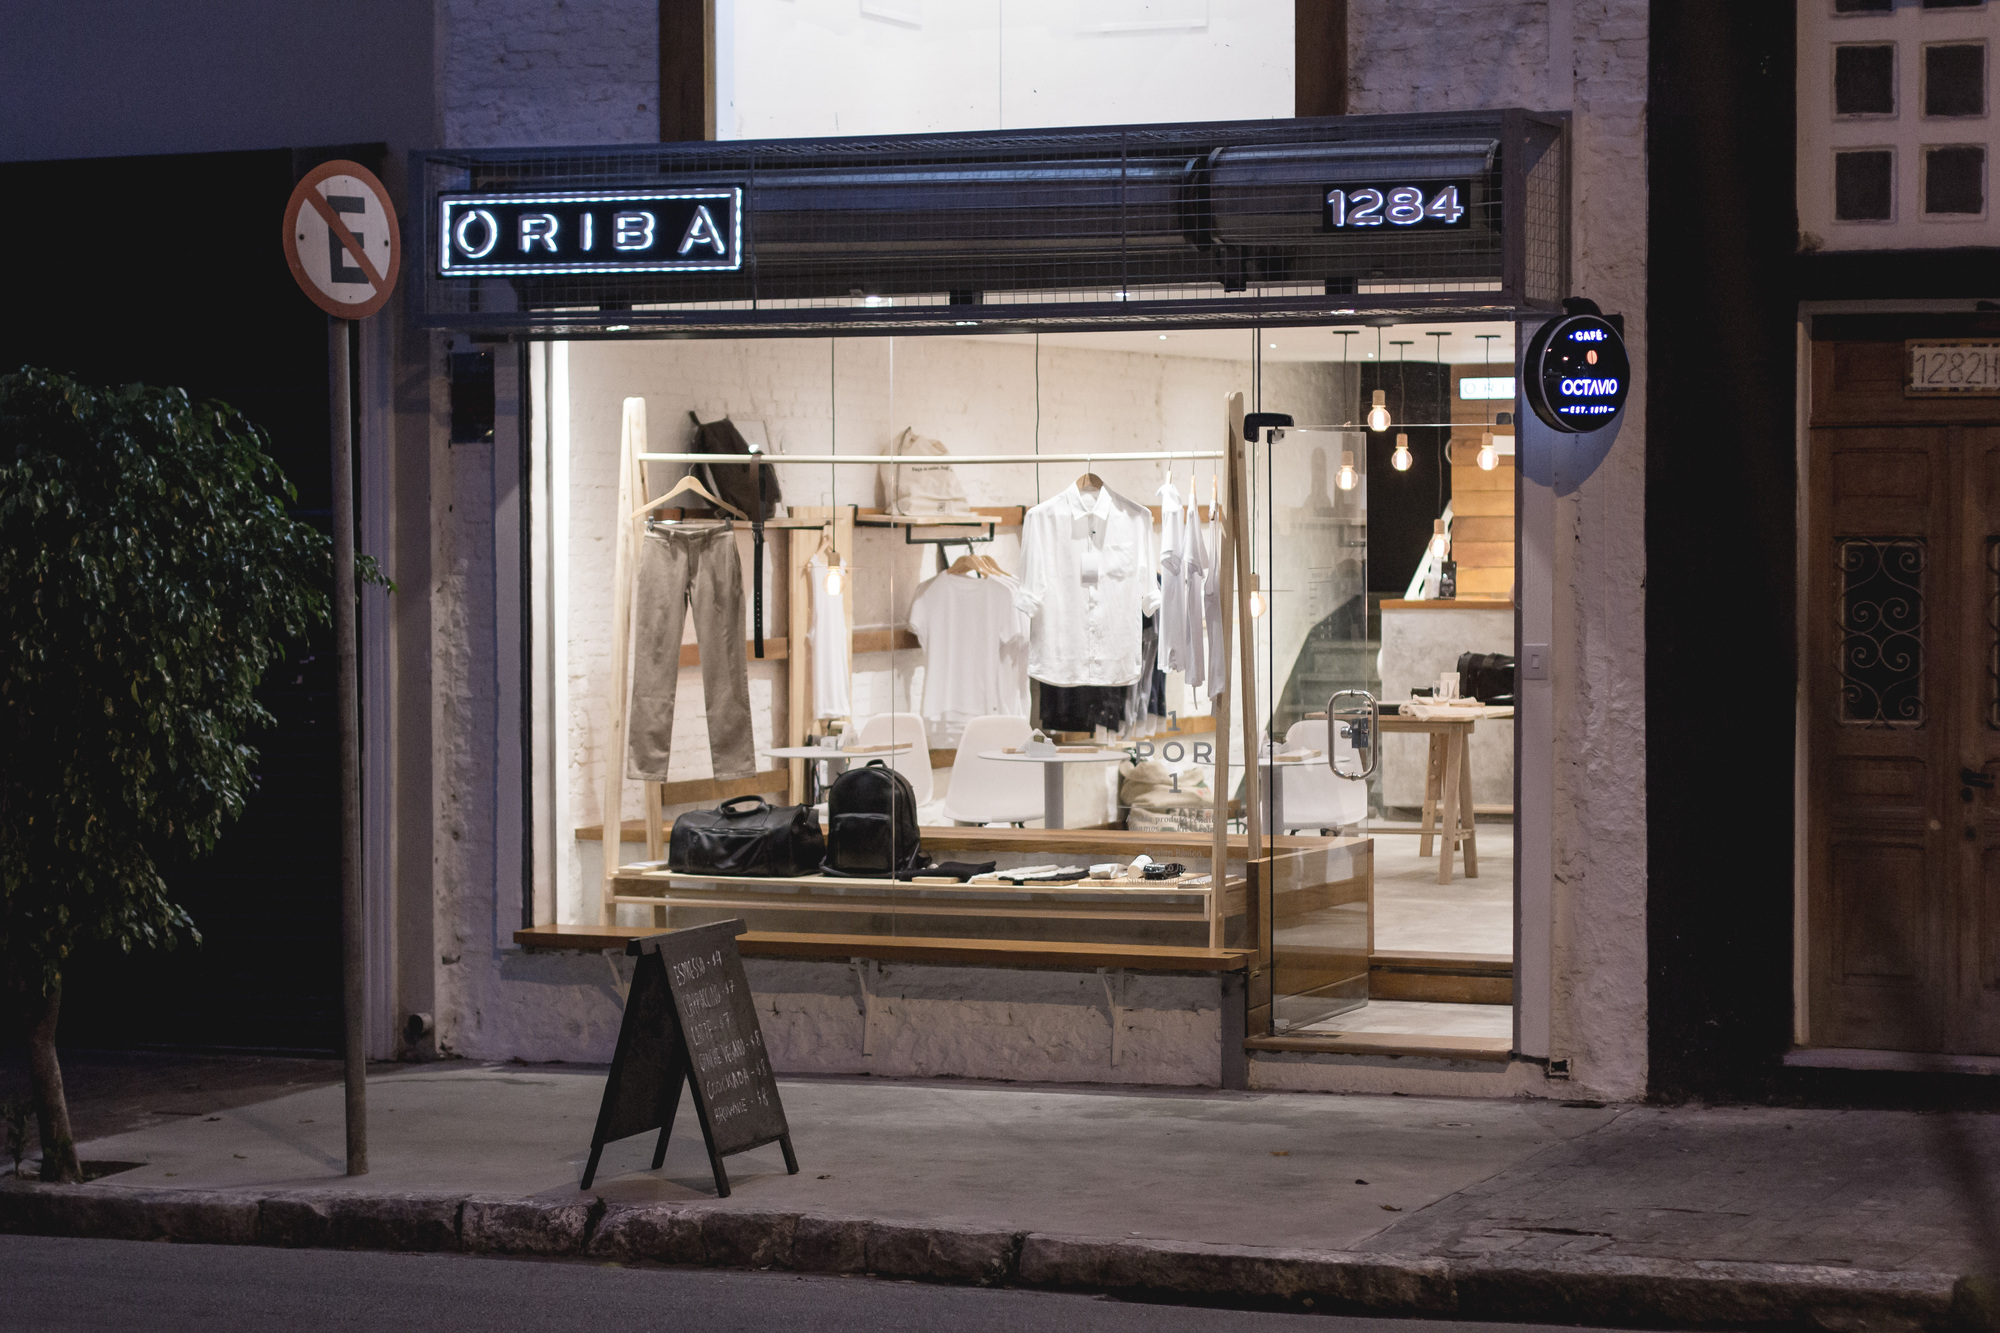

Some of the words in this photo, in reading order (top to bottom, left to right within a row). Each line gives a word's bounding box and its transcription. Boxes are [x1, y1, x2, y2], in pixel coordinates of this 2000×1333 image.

[1326, 185, 1465, 227] 1284
[452, 205, 727, 259] ORIBA
[1574, 329, 1604, 341] CAFÉ
[1915, 351, 1998, 384] 1282H
[1464, 381, 1516, 396] ORI
[1561, 378, 1618, 396] OCTAVIO
[1167, 710, 1181, 731] 1
[1135, 741, 1213, 764] POR
[1168, 772, 1182, 794] 1
